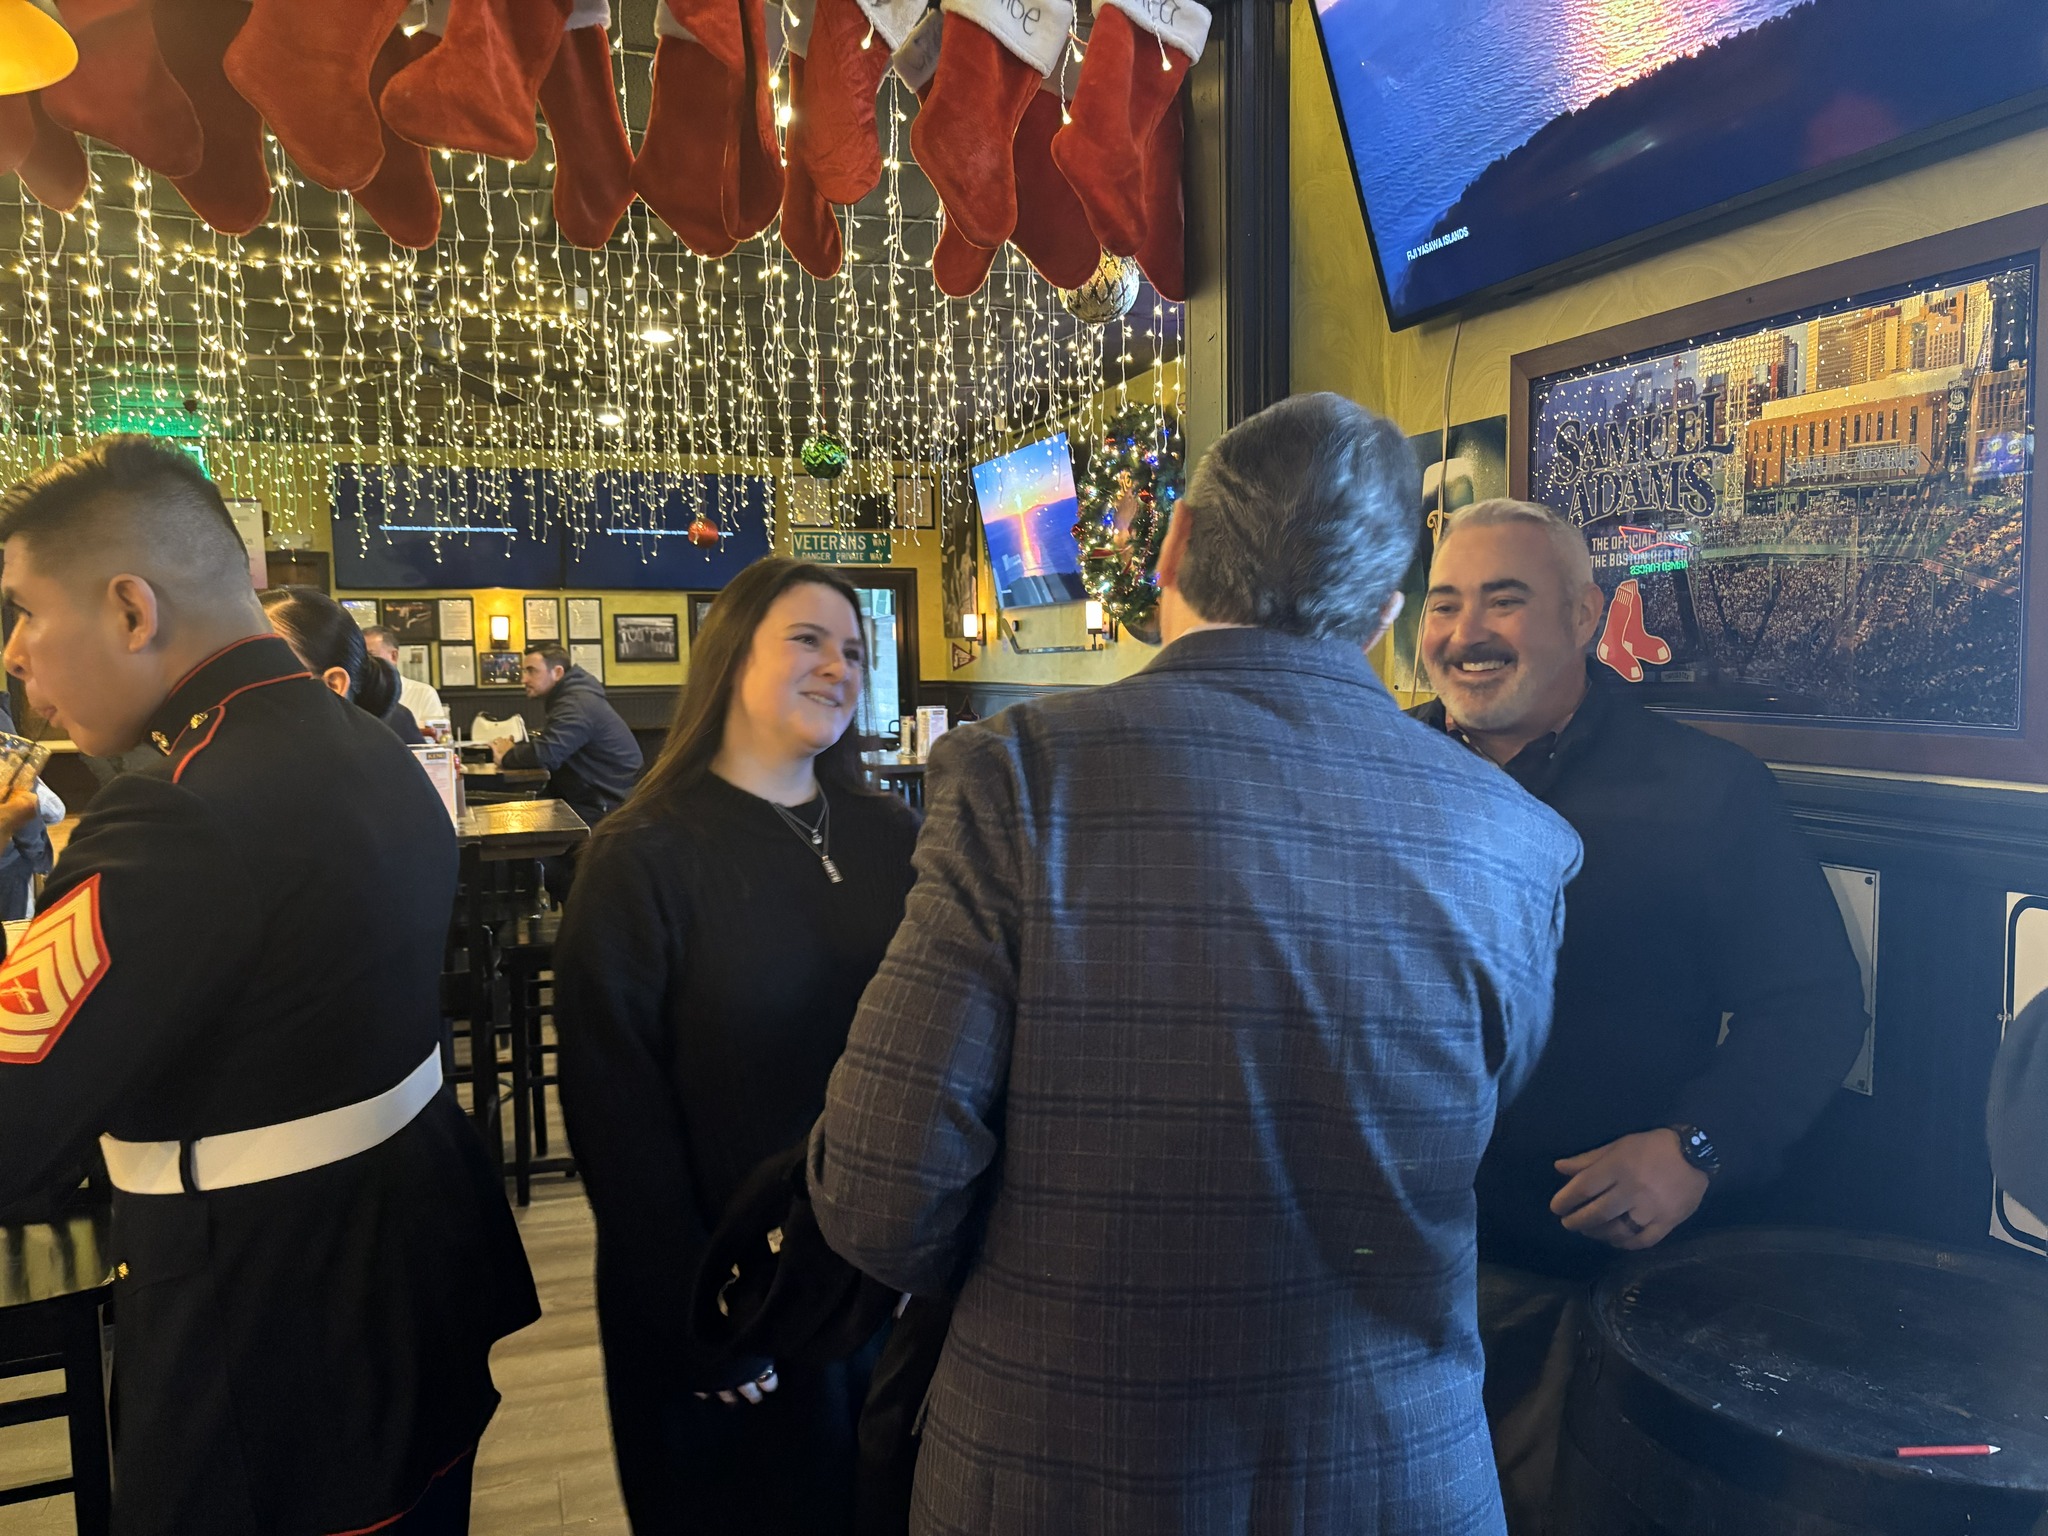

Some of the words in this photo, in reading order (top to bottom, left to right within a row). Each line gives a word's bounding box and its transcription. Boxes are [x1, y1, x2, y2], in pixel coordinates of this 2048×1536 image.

[1417, 237, 1444, 256] YASAWA
[1443, 226, 1469, 246] ISLANDS
[1554, 392, 1737, 485] SAMUEL
[1568, 456, 1717, 528] ADAMS
[794, 534, 867, 551] VETERANS
[1591, 537, 1609, 552] THE
[1611, 533, 1652, 550] OFFICIAL
[835, 551, 864, 561] PRIVATE
[1590, 554, 1607, 569] THE
[1609, 550, 1648, 567] BOSTON
[1650, 549, 1671, 564] RED
[1673, 547, 1695, 562] SOX
